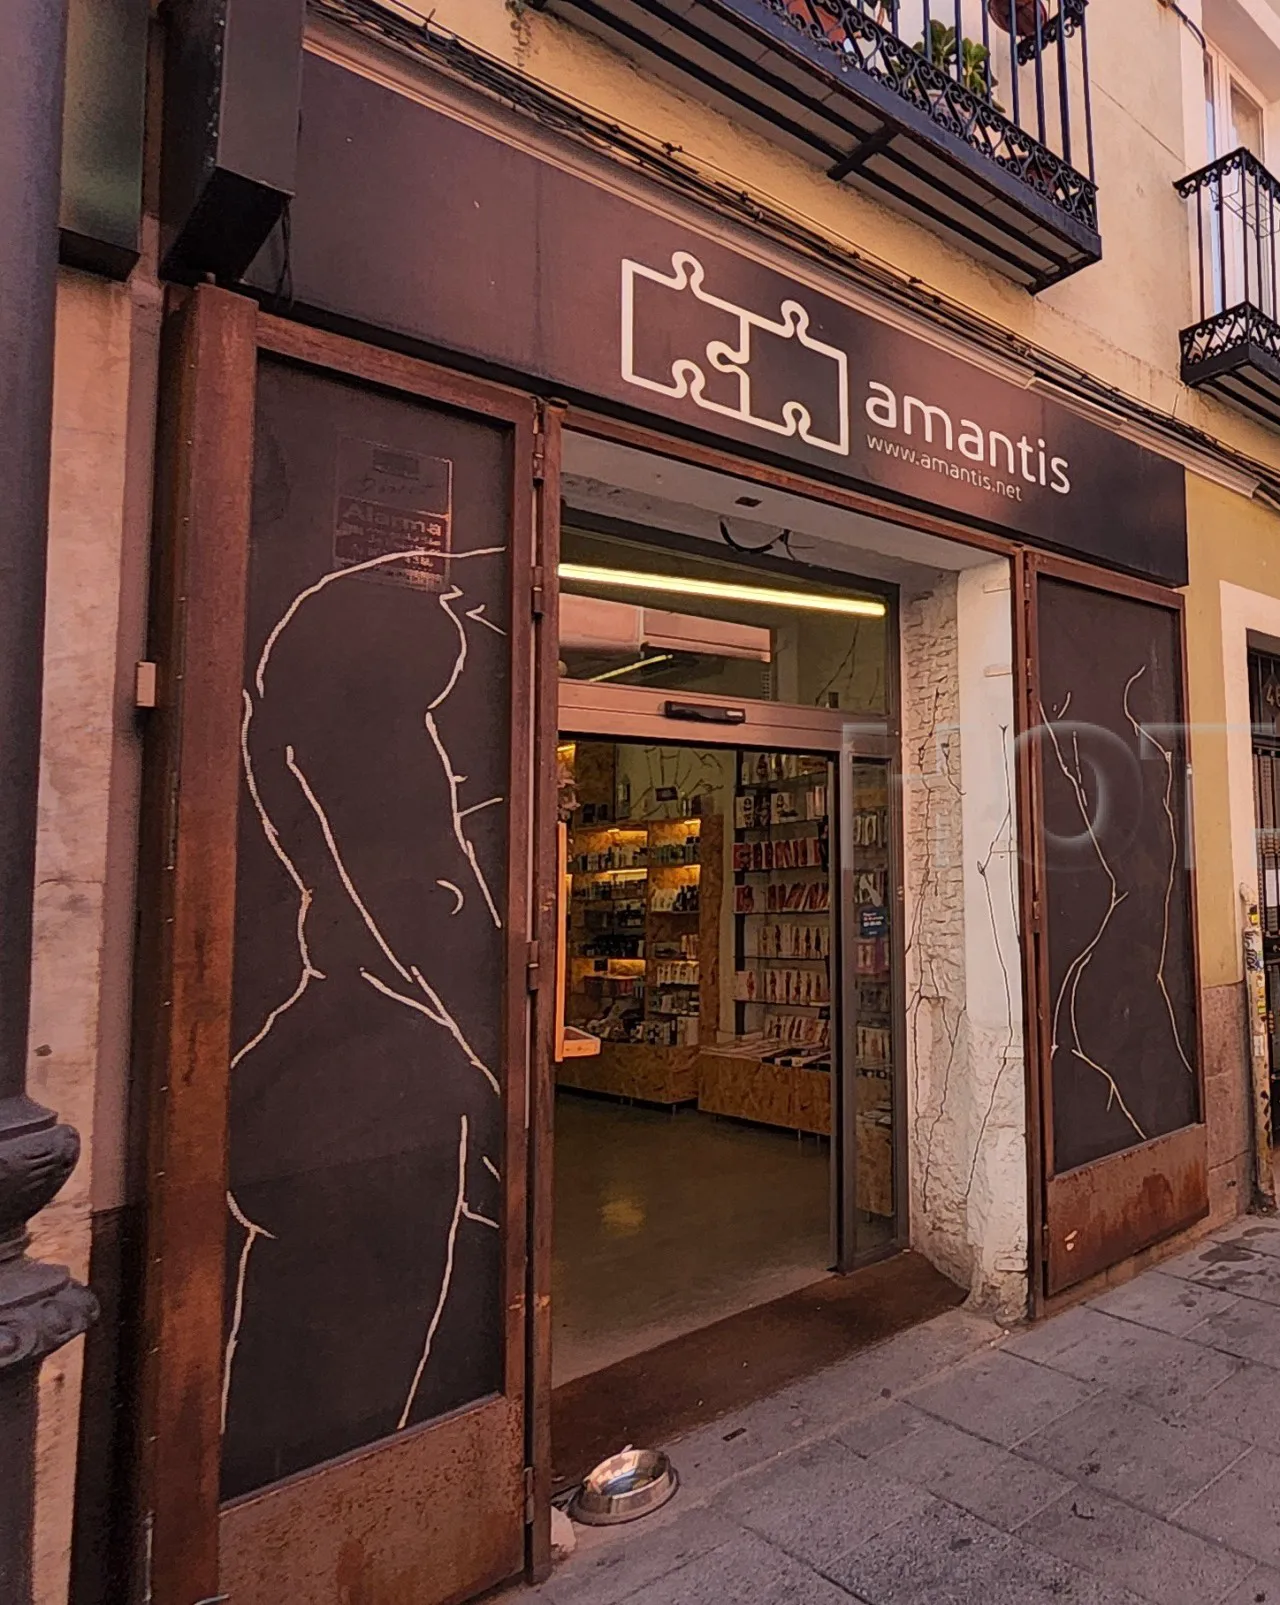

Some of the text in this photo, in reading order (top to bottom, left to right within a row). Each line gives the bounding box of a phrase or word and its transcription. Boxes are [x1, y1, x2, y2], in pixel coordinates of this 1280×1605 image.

[865, 380, 1071, 494] amantis
[866, 433, 1022, 502] www.amantis.net
[342, 502, 442, 537] Alarma
